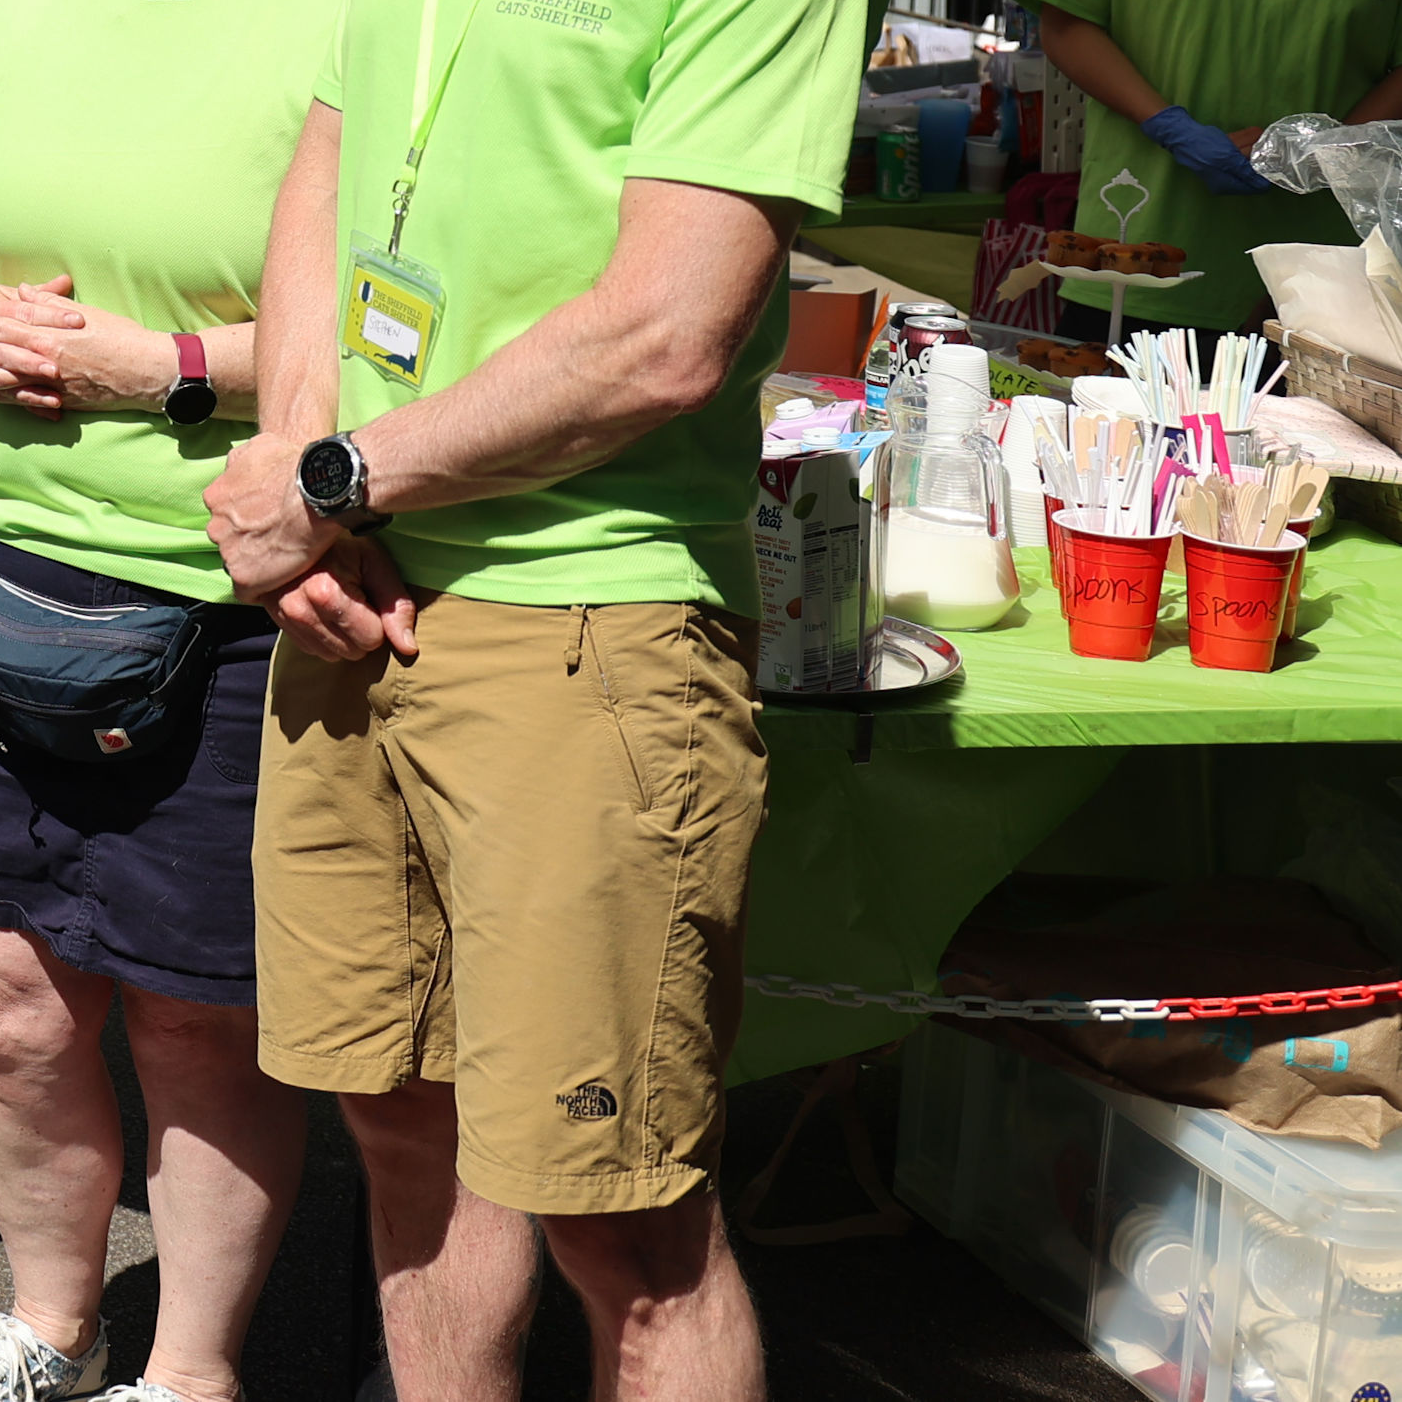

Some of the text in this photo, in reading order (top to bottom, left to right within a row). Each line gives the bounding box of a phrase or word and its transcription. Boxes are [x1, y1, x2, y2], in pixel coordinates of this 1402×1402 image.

[495, 0, 604, 35] CATS SHELTER
[372, 299, 419, 328] CATS SHELTER
[373, 288, 423, 321] THE SHEFFIELD
[555, 1093, 598, 1107] NORTH
[576, 1085, 599, 1096] THE
[567, 1105, 597, 1119] FACE
